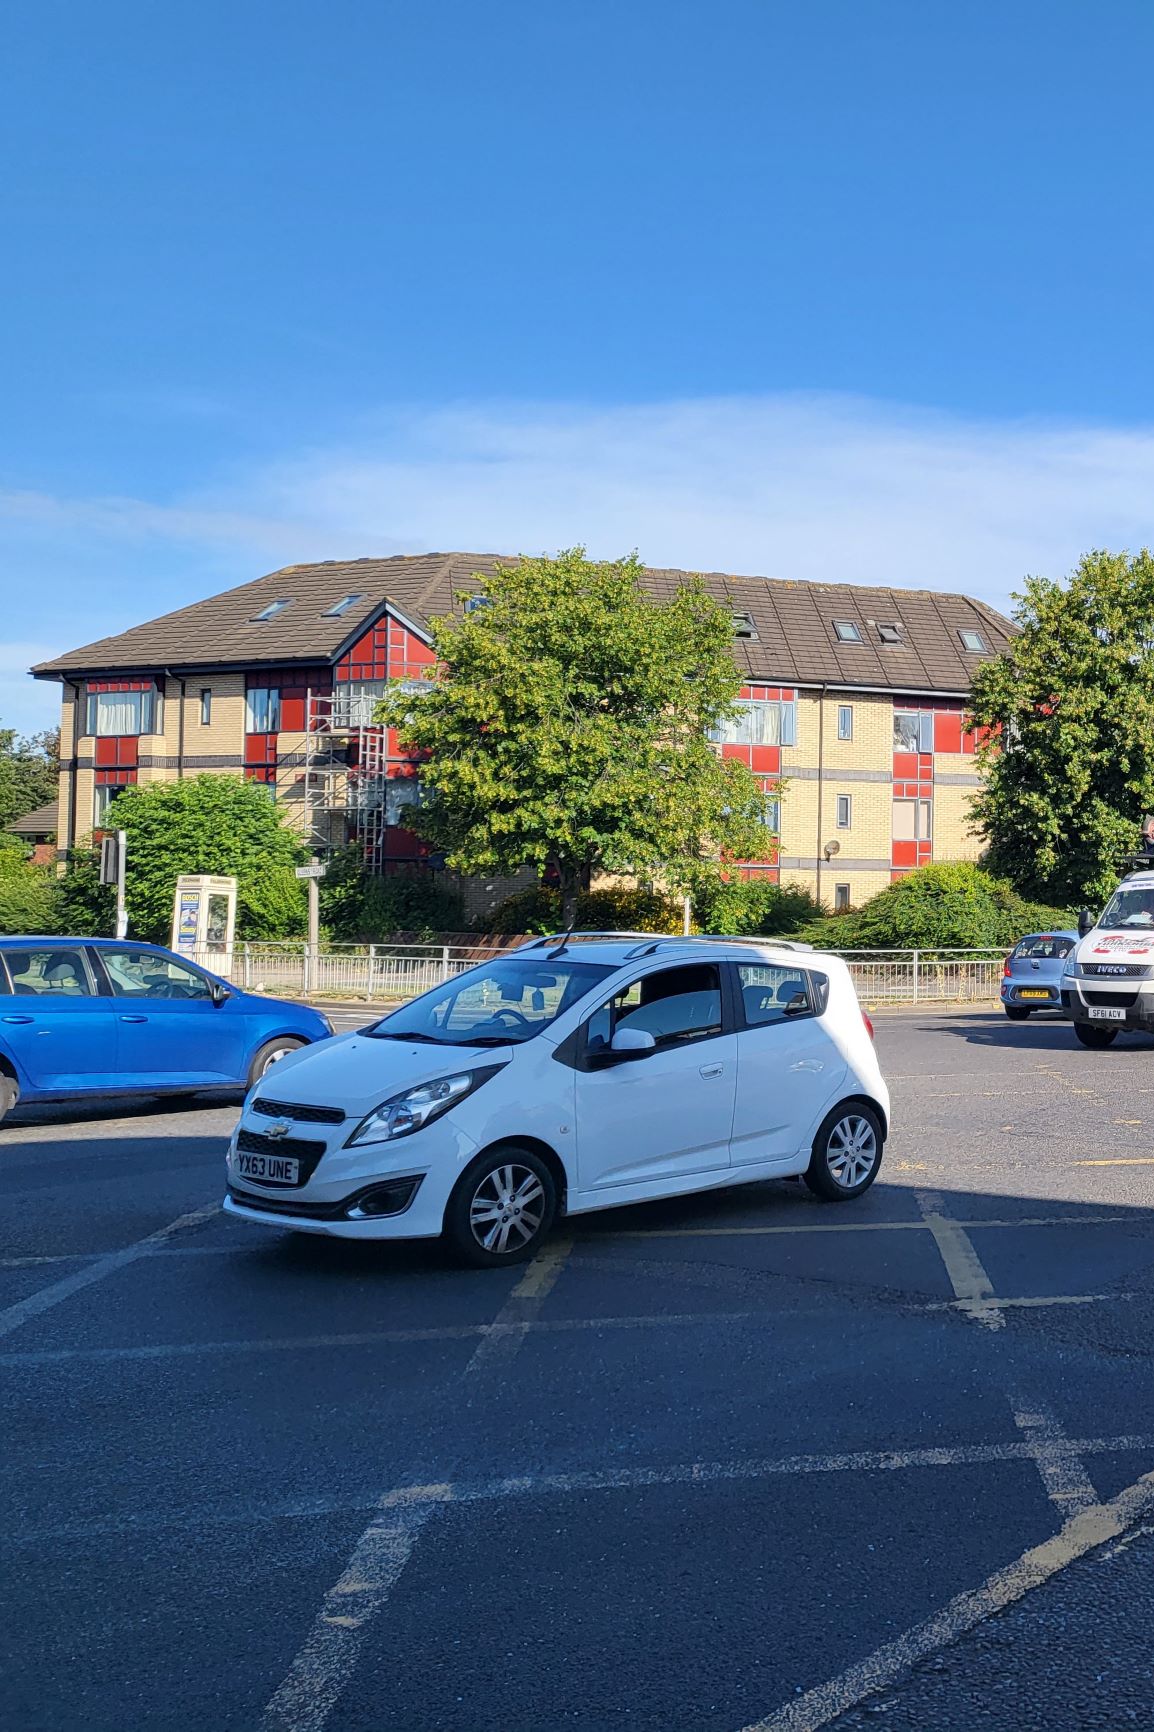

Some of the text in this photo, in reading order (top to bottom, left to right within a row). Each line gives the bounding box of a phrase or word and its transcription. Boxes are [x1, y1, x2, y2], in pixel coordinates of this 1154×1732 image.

[1096, 965, 1127, 973] IVECO
[1092, 1009, 1121, 1018] SF61 ACV
[239, 1153, 293, 1180] YX63 UNE
